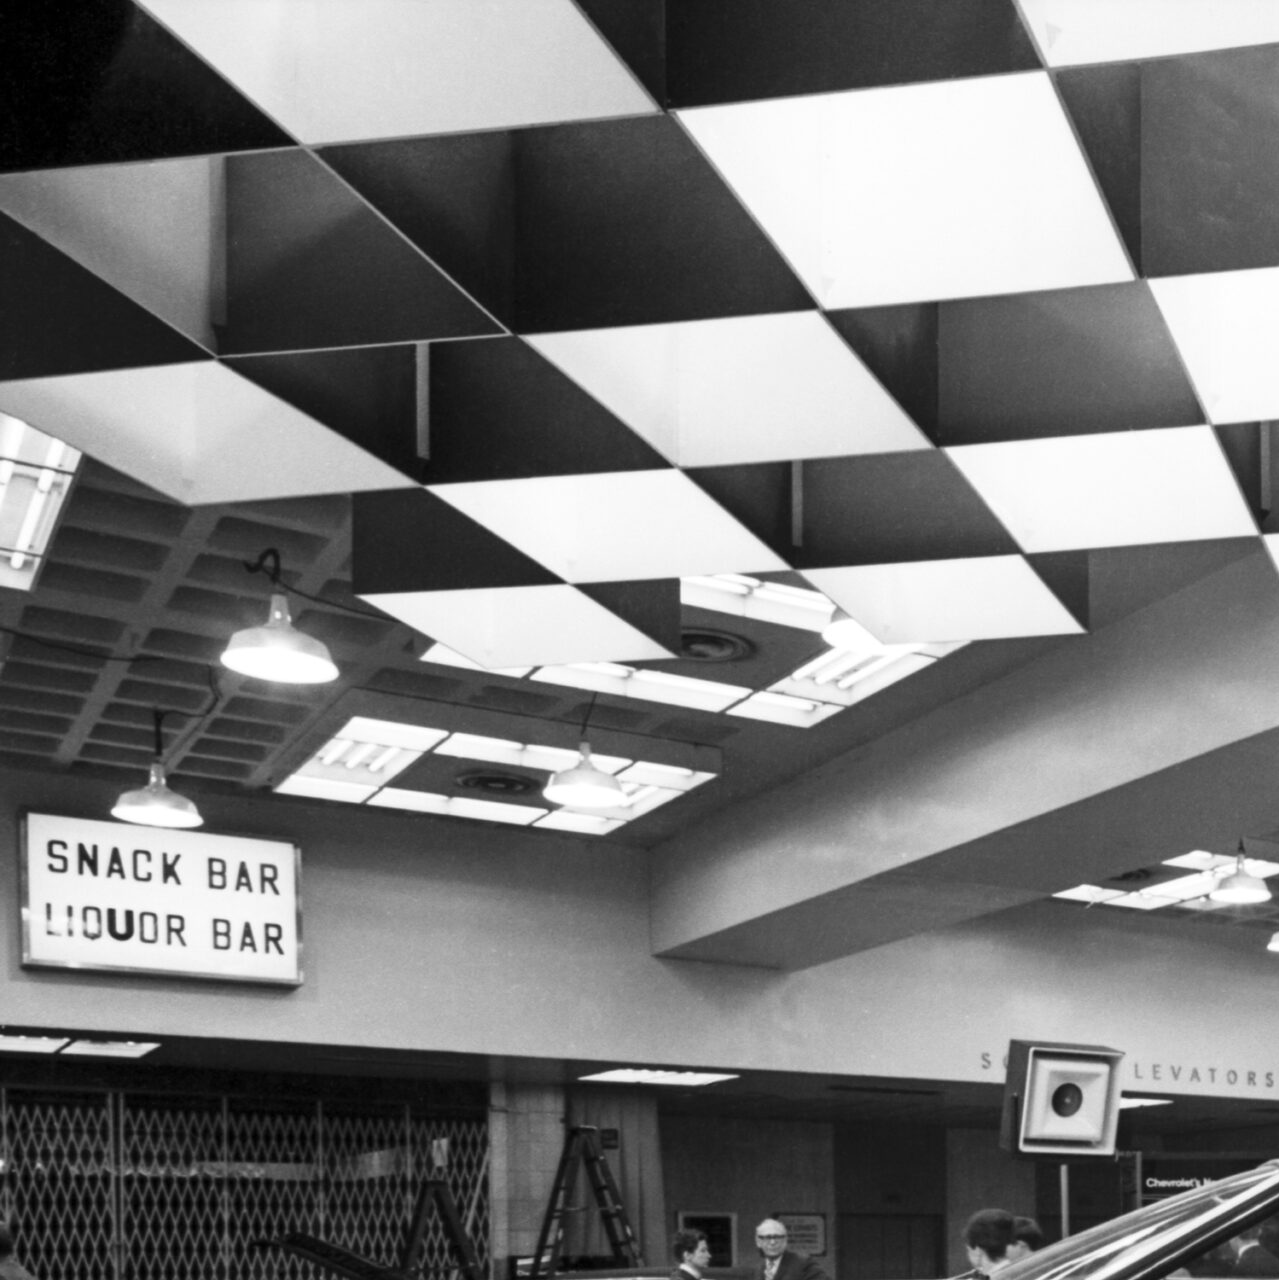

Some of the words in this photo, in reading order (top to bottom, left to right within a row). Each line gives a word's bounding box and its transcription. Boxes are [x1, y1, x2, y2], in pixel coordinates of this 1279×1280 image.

[46, 840, 182, 886] SNACK
[207, 856, 280, 896] BAR
[45, 902, 187, 947] LIQUOR
[212, 918, 285, 956] BAR
[1134, 1063, 1275, 1088] LEVATORS
[1145, 1177, 1201, 1189] Chevrolet's
